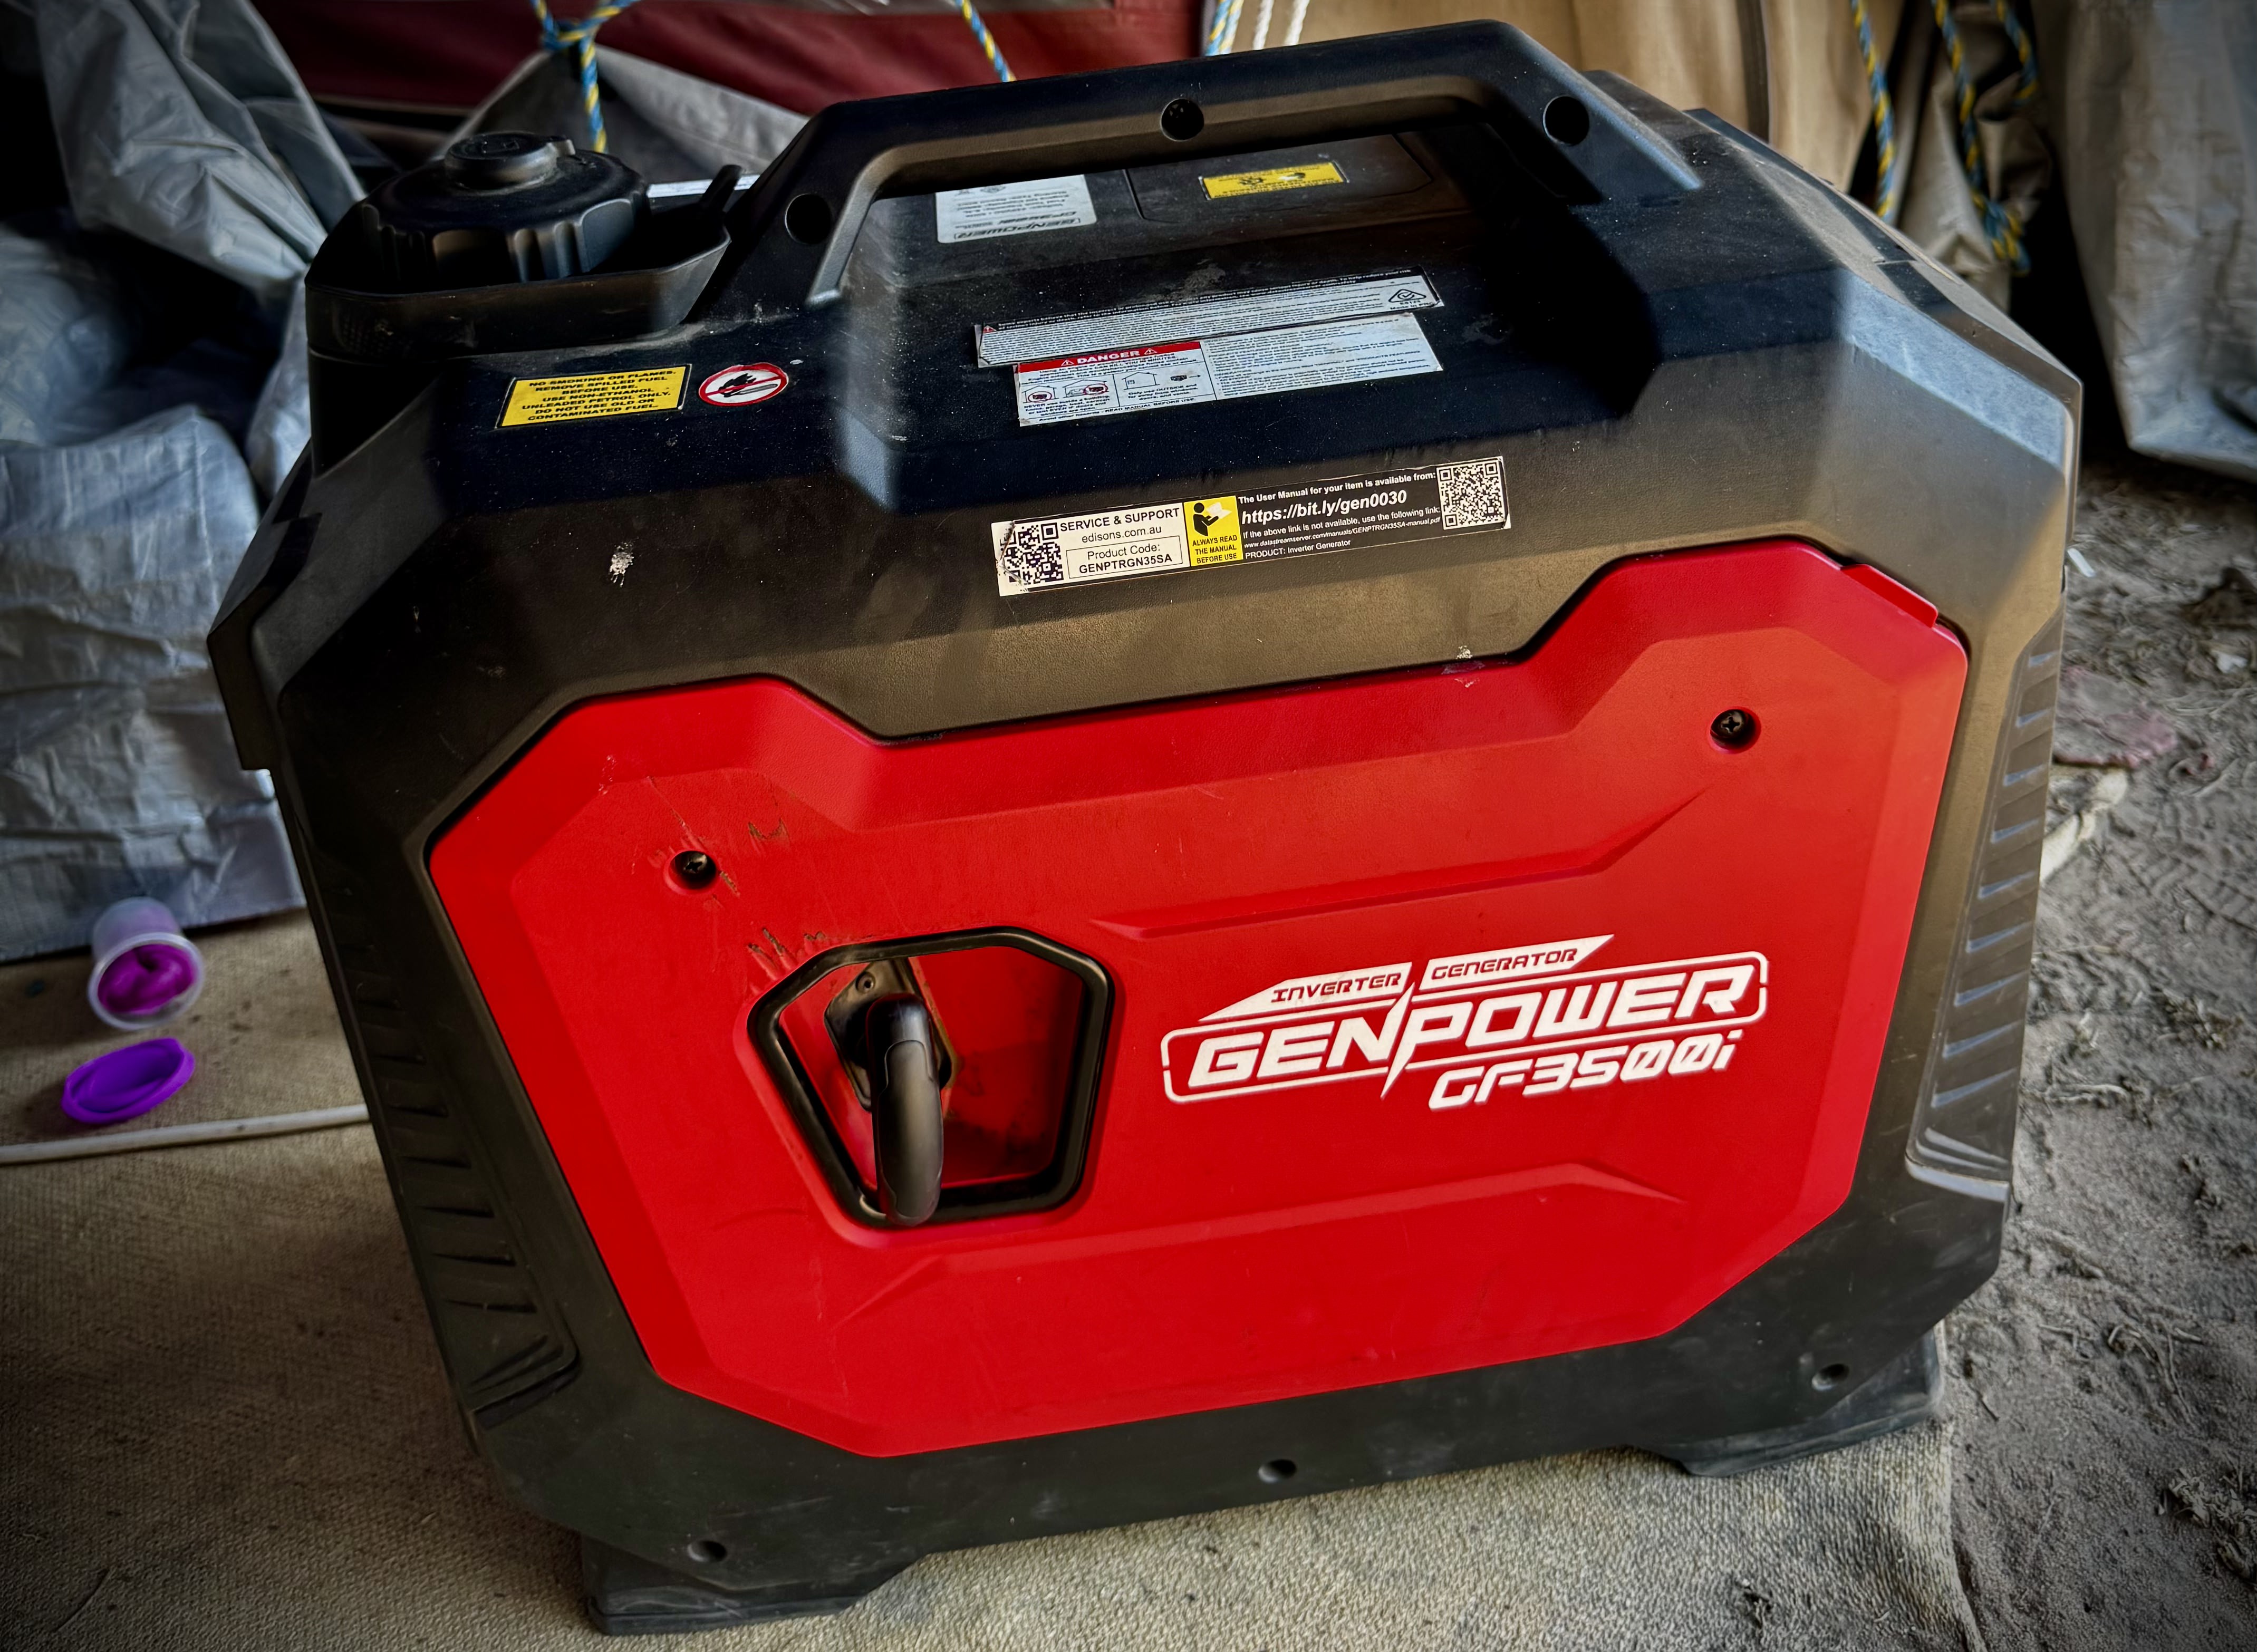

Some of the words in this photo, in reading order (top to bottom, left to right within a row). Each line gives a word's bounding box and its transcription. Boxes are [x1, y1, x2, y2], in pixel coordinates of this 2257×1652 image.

[1077, 351, 1140, 364] DANGER
[570, 389, 654, 399] NON-ETHANOL
[522, 400, 585, 409] UNLEADED
[528, 408, 621, 420] CONTAMINATED
[1278, 488, 1308, 499] Manual
[1324, 485, 1343, 494] your
[1345, 481, 1363, 490] item
[1375, 475, 1412, 486] available
[1242, 489, 1407, 525] https://bit.ly/gen0030
[1060, 517, 1110, 532] SERVICE
[1114, 516, 1121, 525] &
[1125, 508, 1180, 523] SUPPORT
[1263, 527, 1286, 536] above
[1325, 517, 1360, 528] available,
[1391, 509, 1423, 519] following
[1082, 526, 1162, 543] edisons.com.au
[1192, 537, 1218, 546] ALWAYS
[1087, 547, 1127, 560] Product
[1130, 544, 1160, 555] Code:
[1210, 545, 1237, 554] MANUAL
[1246, 548, 1286, 559] PRODUCT:
[1288, 544, 1314, 554] Inverter
[1316, 539, 1351, 549] Generator
[1079, 554, 1172, 574] GENPTRGN35SA
[1197, 555, 1222, 564] BEFORE
[1431, 947, 1579, 982] GENERATOR
[1270, 971, 1403, 1003] INVERTER
[1188, 965, 1755, 1099] GENPOWER
[1428, 1030, 1743, 1112] GF3500i
